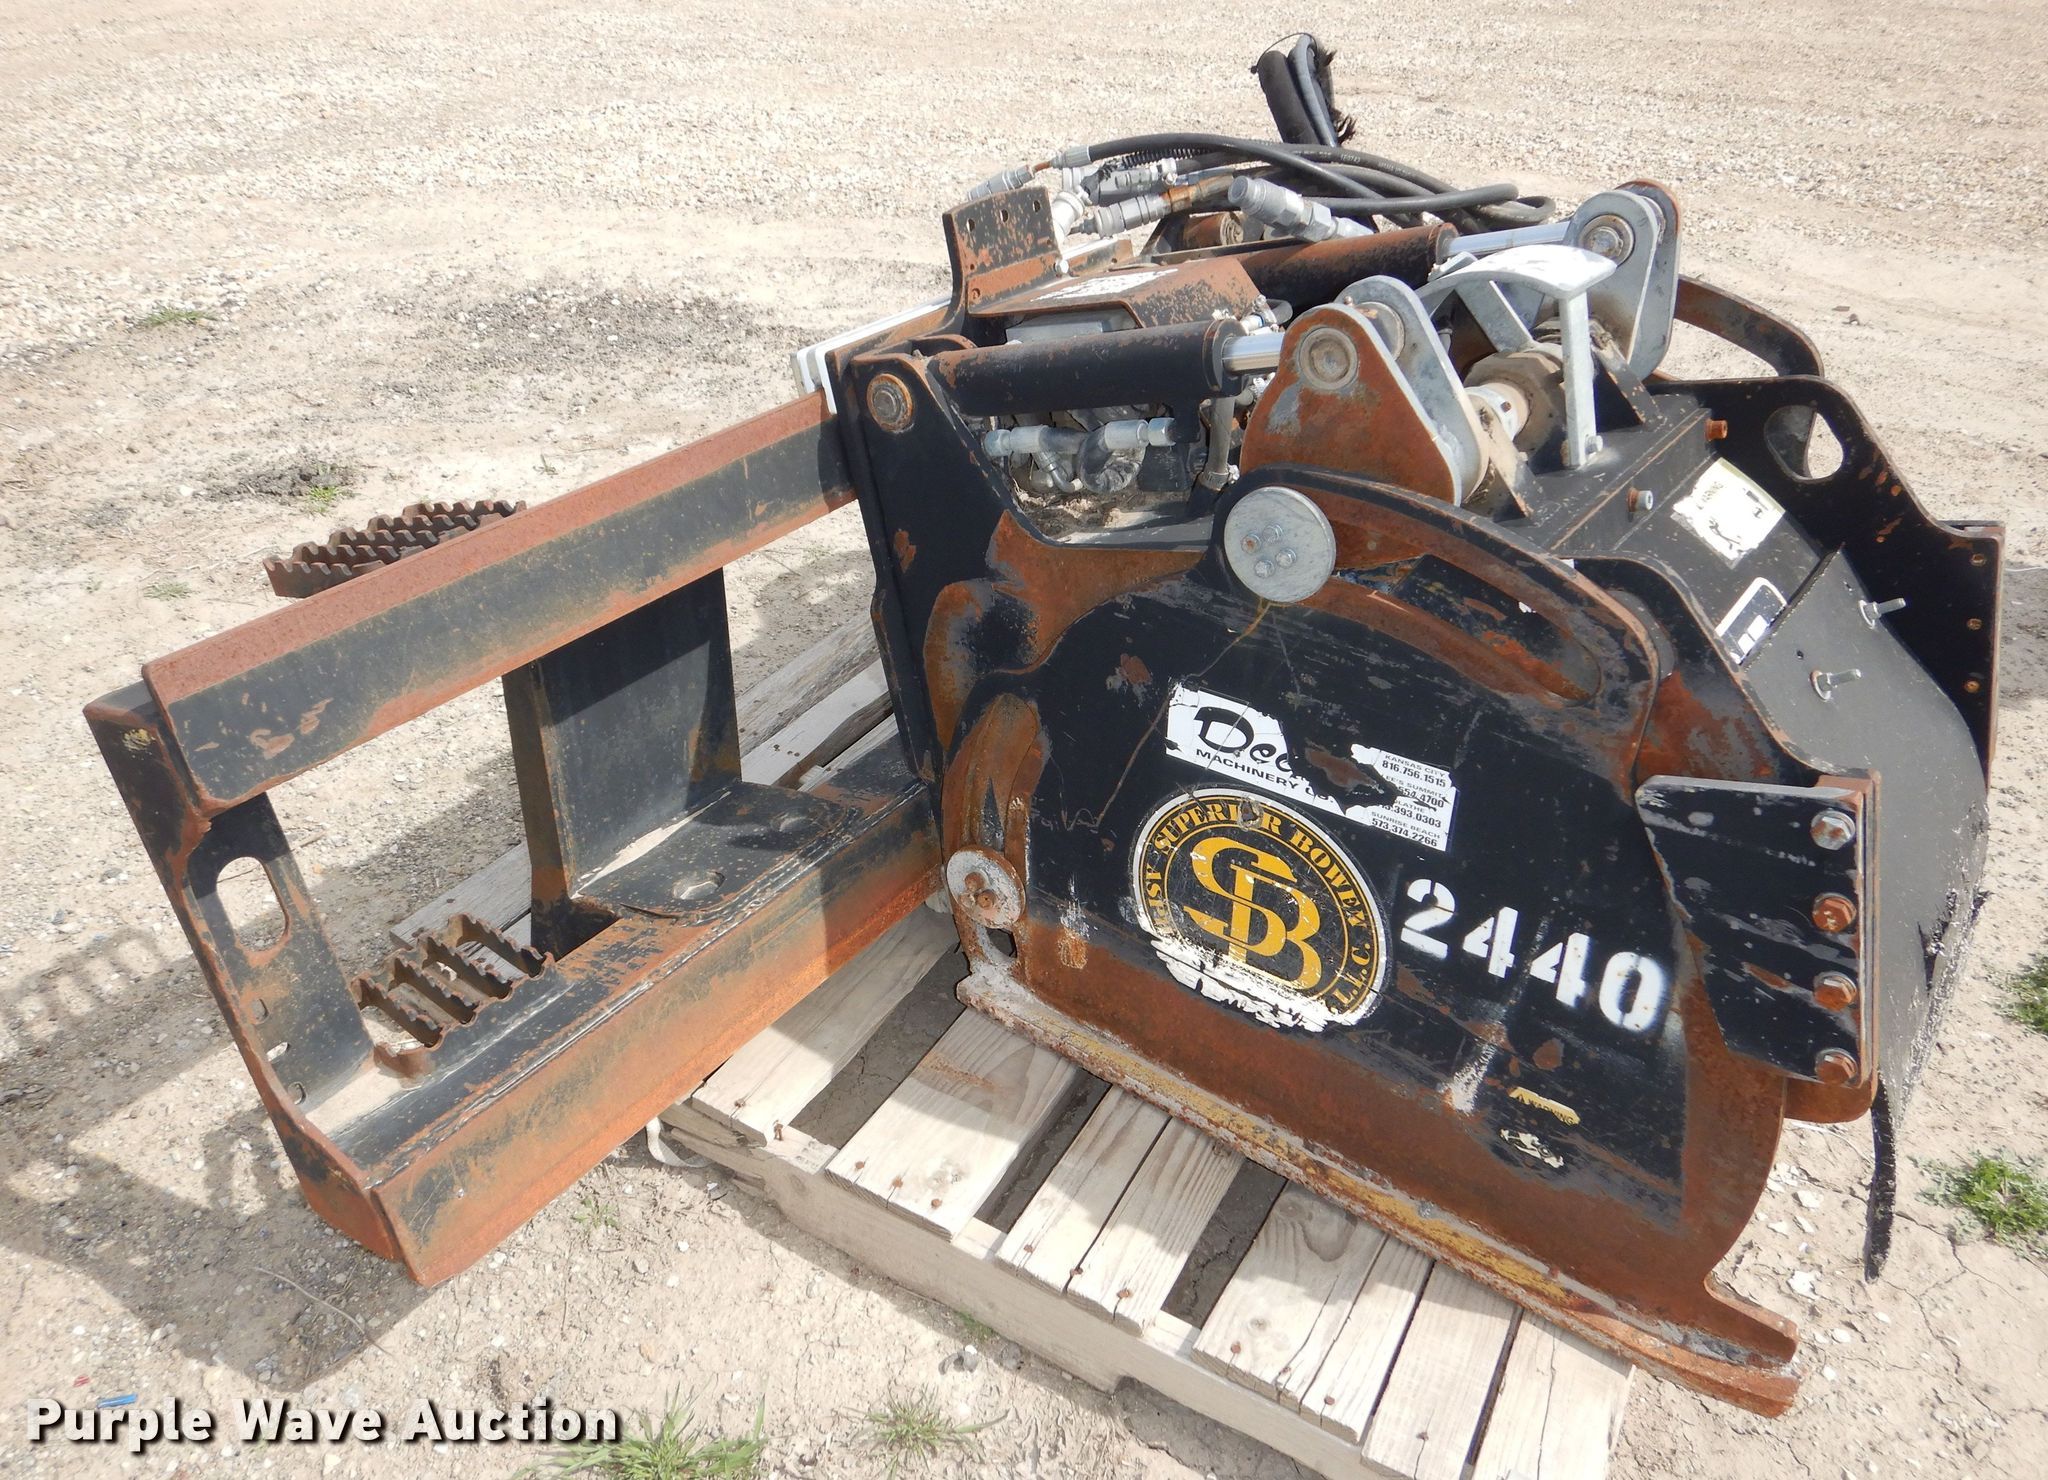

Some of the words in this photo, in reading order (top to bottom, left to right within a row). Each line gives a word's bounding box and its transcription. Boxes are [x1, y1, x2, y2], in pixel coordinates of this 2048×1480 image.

[1196, 749, 1298, 789] MACHINERY
[1382, 760, 1446, 788] 816.756.1515
[1385, 755, 1421, 770] KANSAS
[1424, 768, 1445, 778] CITY
[1407, 782, 1443, 798] SUMMIT
[1153, 802, 1282, 855] SUPERIR
[1371, 812, 1409, 827] SUNRISE
[1410, 825, 1441, 839] BEACH
[1372, 818, 1437, 847] 573.374.2266
[1401, 878, 1667, 1033] 2440
